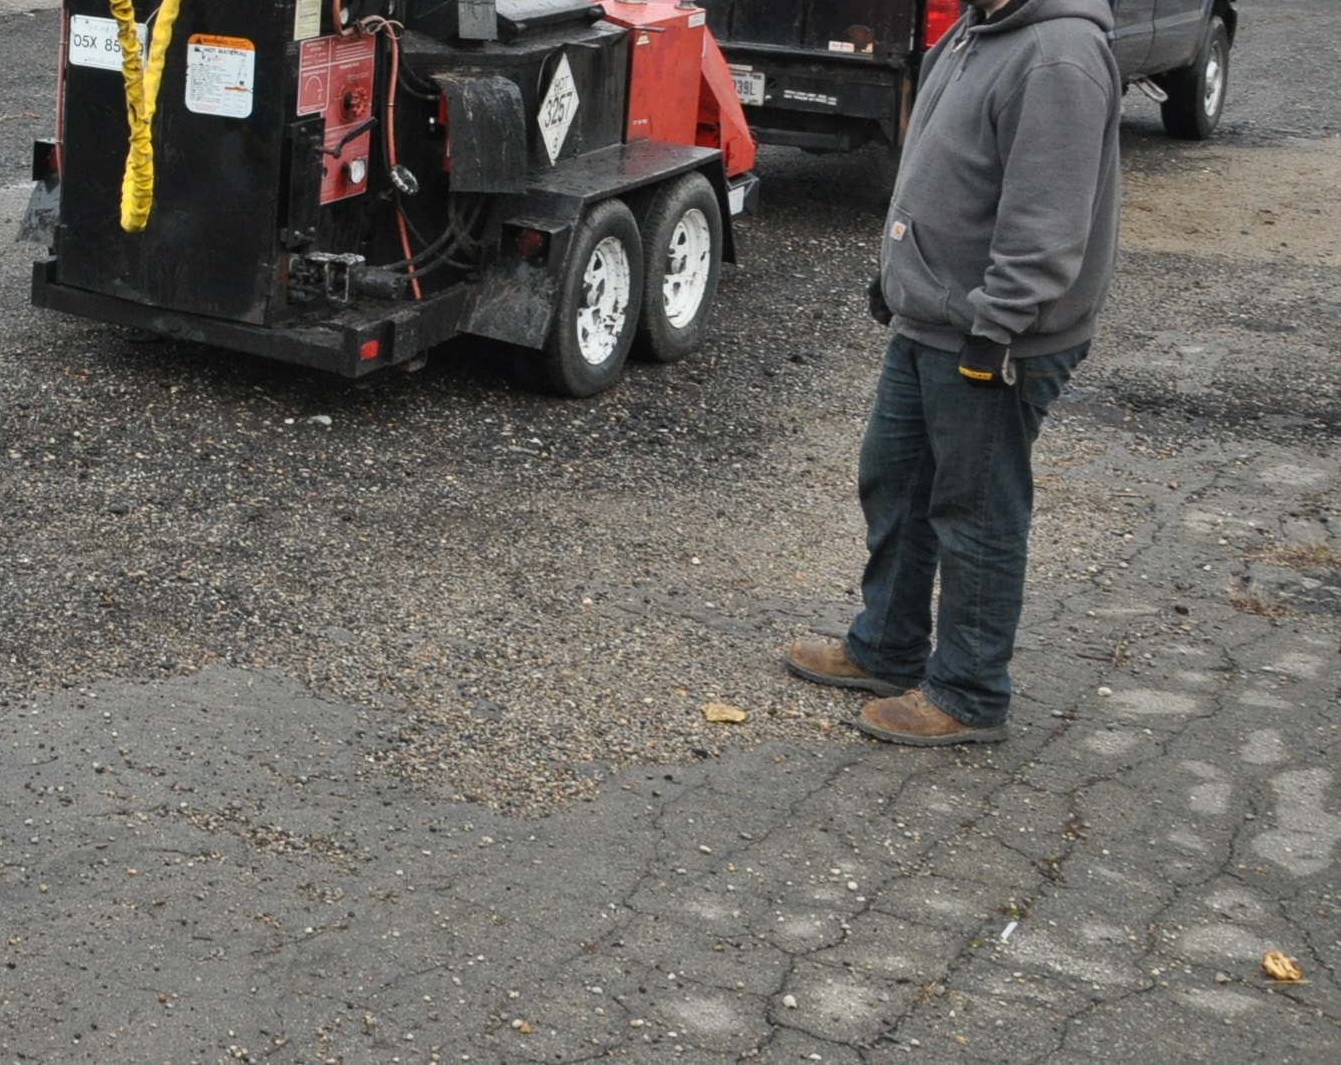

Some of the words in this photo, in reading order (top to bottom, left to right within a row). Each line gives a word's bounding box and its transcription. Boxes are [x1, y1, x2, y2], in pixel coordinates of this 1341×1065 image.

[73, 33, 97, 51] 05X
[553, 76, 569, 93] HOT
[544, 90, 573, 129] 3257
